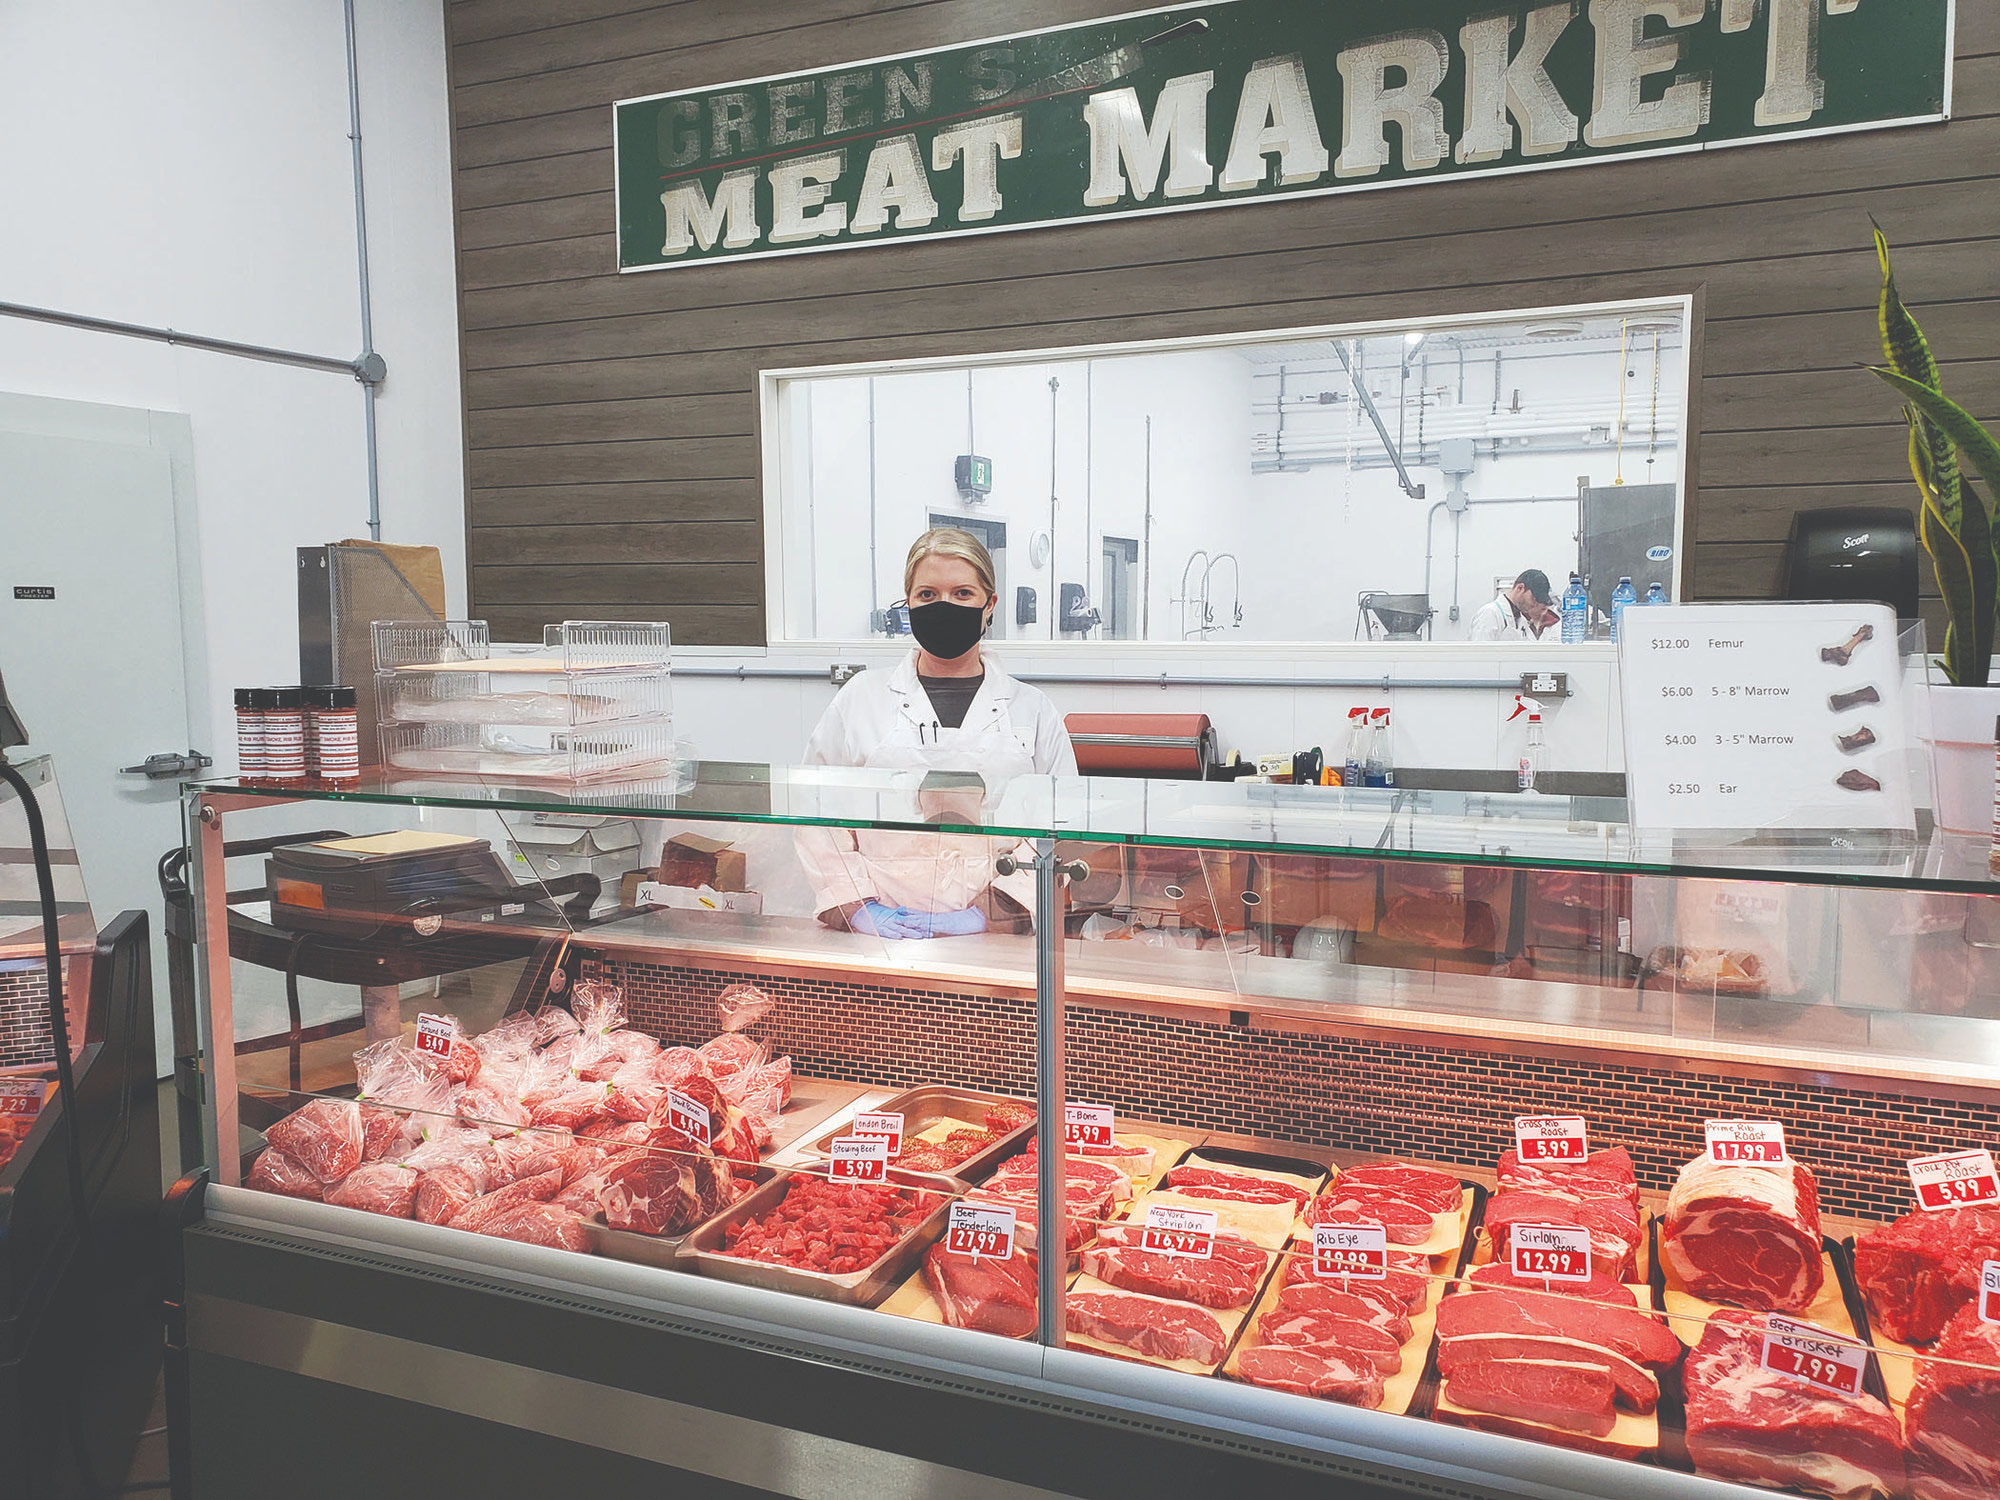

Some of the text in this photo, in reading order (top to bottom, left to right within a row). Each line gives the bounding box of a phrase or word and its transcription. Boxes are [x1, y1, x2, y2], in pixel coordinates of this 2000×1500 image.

[657, 60, 935, 168] GREEN
[659, 0, 1861, 257] MEAT MARKET
[1842, 533, 1870, 549] Scott
[1651, 638, 1744, 650] $12.00 Femur
[1661, 686, 1694, 698] $6.00
[1745, 686, 1790, 696] Marrow
[1665, 734, 1697, 747] $4.00
[1749, 734, 1794, 745] Marrow
[1668, 783, 1738, 796] $2.50 Ear
[640, 890, 654, 901] XL
[724, 900, 735, 910] XL
[1066, 1110, 1098, 1121] T-Bone
[855, 1117, 899, 1130] London Broil
[1517, 1119, 1559, 1129] Cross Rib
[1706, 1123, 1755, 1132] Prime Rib
[1065, 1124, 1100, 1141] 15.99
[1540, 1127, 1569, 1136] Roast
[1734, 1131, 1766, 1140] Roast
[833, 1144, 877, 1156] Stewing Beef
[1536, 1140, 1569, 1156] 5.99
[1717, 1143, 1765, 1160] 17.99
[846, 1160, 873, 1176] 5.99
[1943, 1163, 1982, 1180] Roast
[1938, 1179, 1980, 1200] 5.99
[956, 1208, 978, 1219] Beef
[1150, 1209, 1186, 1219] New York
[951, 1219, 1002, 1234] Tenderloin
[1153, 1228, 1197, 1250] 16.99
[1316, 1232, 1359, 1247] Rib Eye
[1323, 1250, 1368, 1271] 19.99
[1522, 1251, 1571, 1272] 12.99
[1769, 1318, 1796, 1333] Beef
[1781, 1334, 1844, 1358] Brisket
[1792, 1352, 1838, 1383] 7.99
